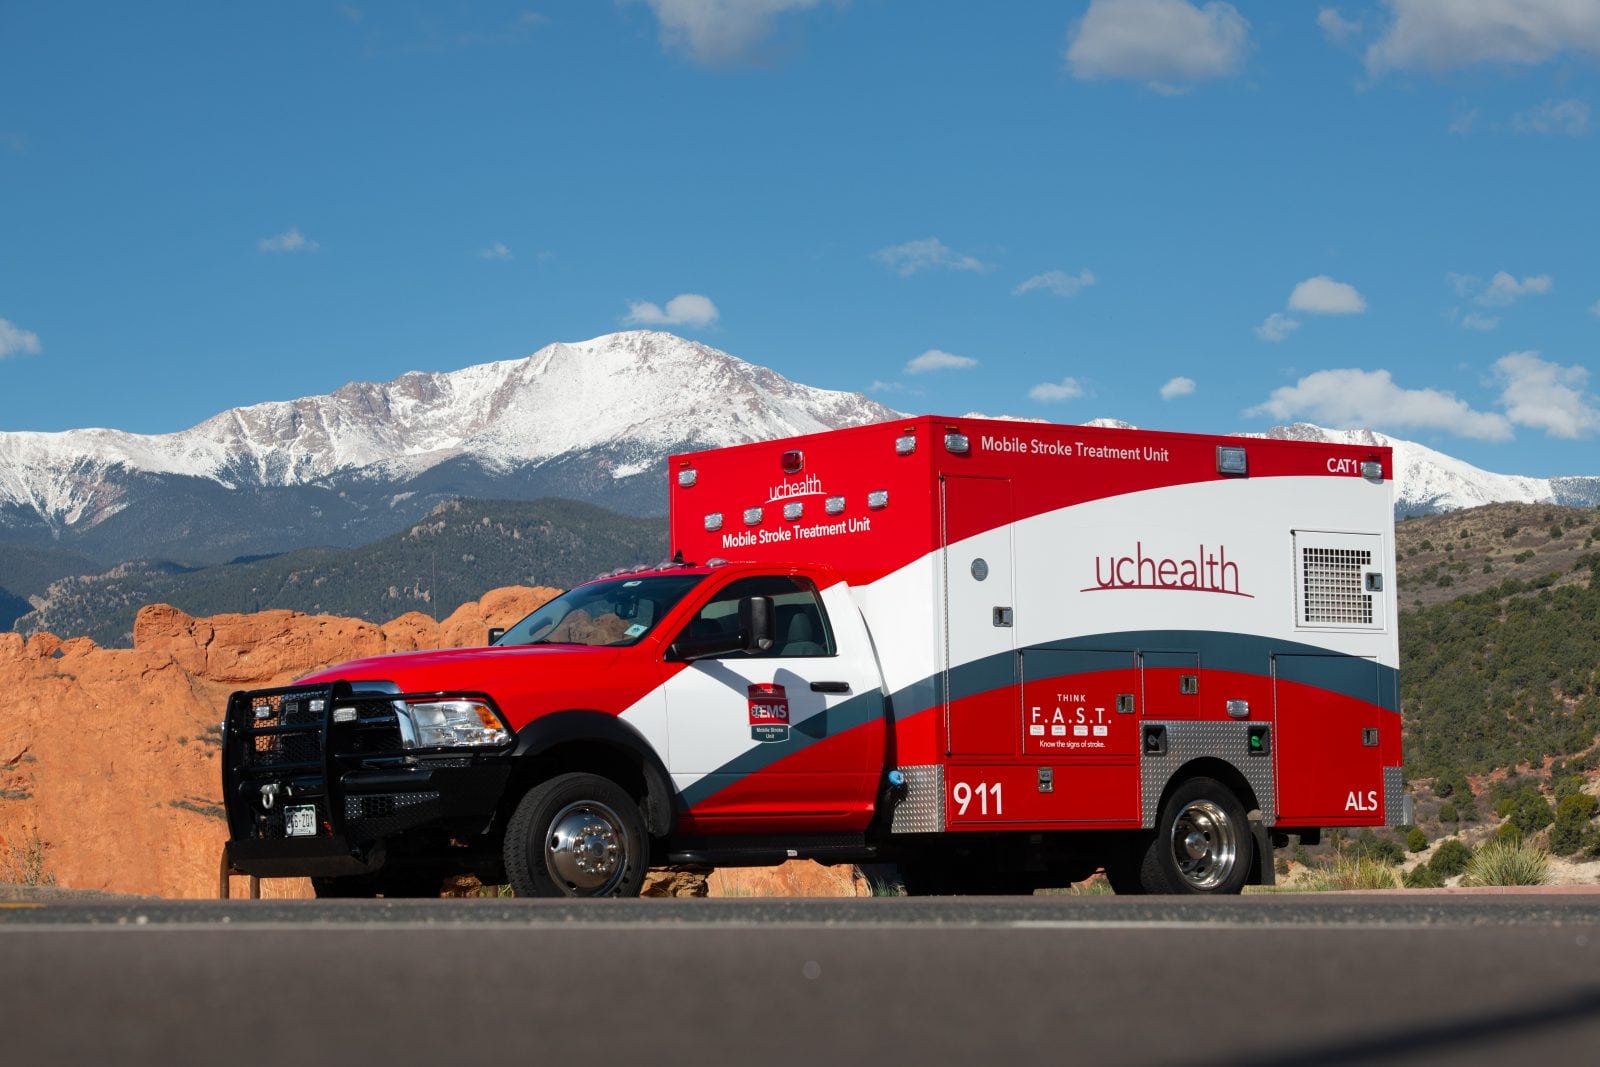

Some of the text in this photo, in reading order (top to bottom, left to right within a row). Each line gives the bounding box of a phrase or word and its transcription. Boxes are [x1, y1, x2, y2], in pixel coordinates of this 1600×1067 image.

[981, 435, 1169, 462] Mobile Stroke Treatment Unit
[1327, 458, 1358, 474] CAT1
[769, 473, 821, 500] uchealth
[722, 517, 871, 549] Mobile Stroke Treatment Unit
[1095, 541, 1240, 594] uchealth
[1057, 694, 1086, 702] THINK
[760, 704, 787, 719] EMS
[1040, 740, 1056, 748] Know
[1056, 740, 1066, 748] the
[1066, 740, 1081, 750] signs
[1081, 740, 1087, 748] of
[953, 782, 1002, 815] 911
[1345, 791, 1378, 811] ALS
